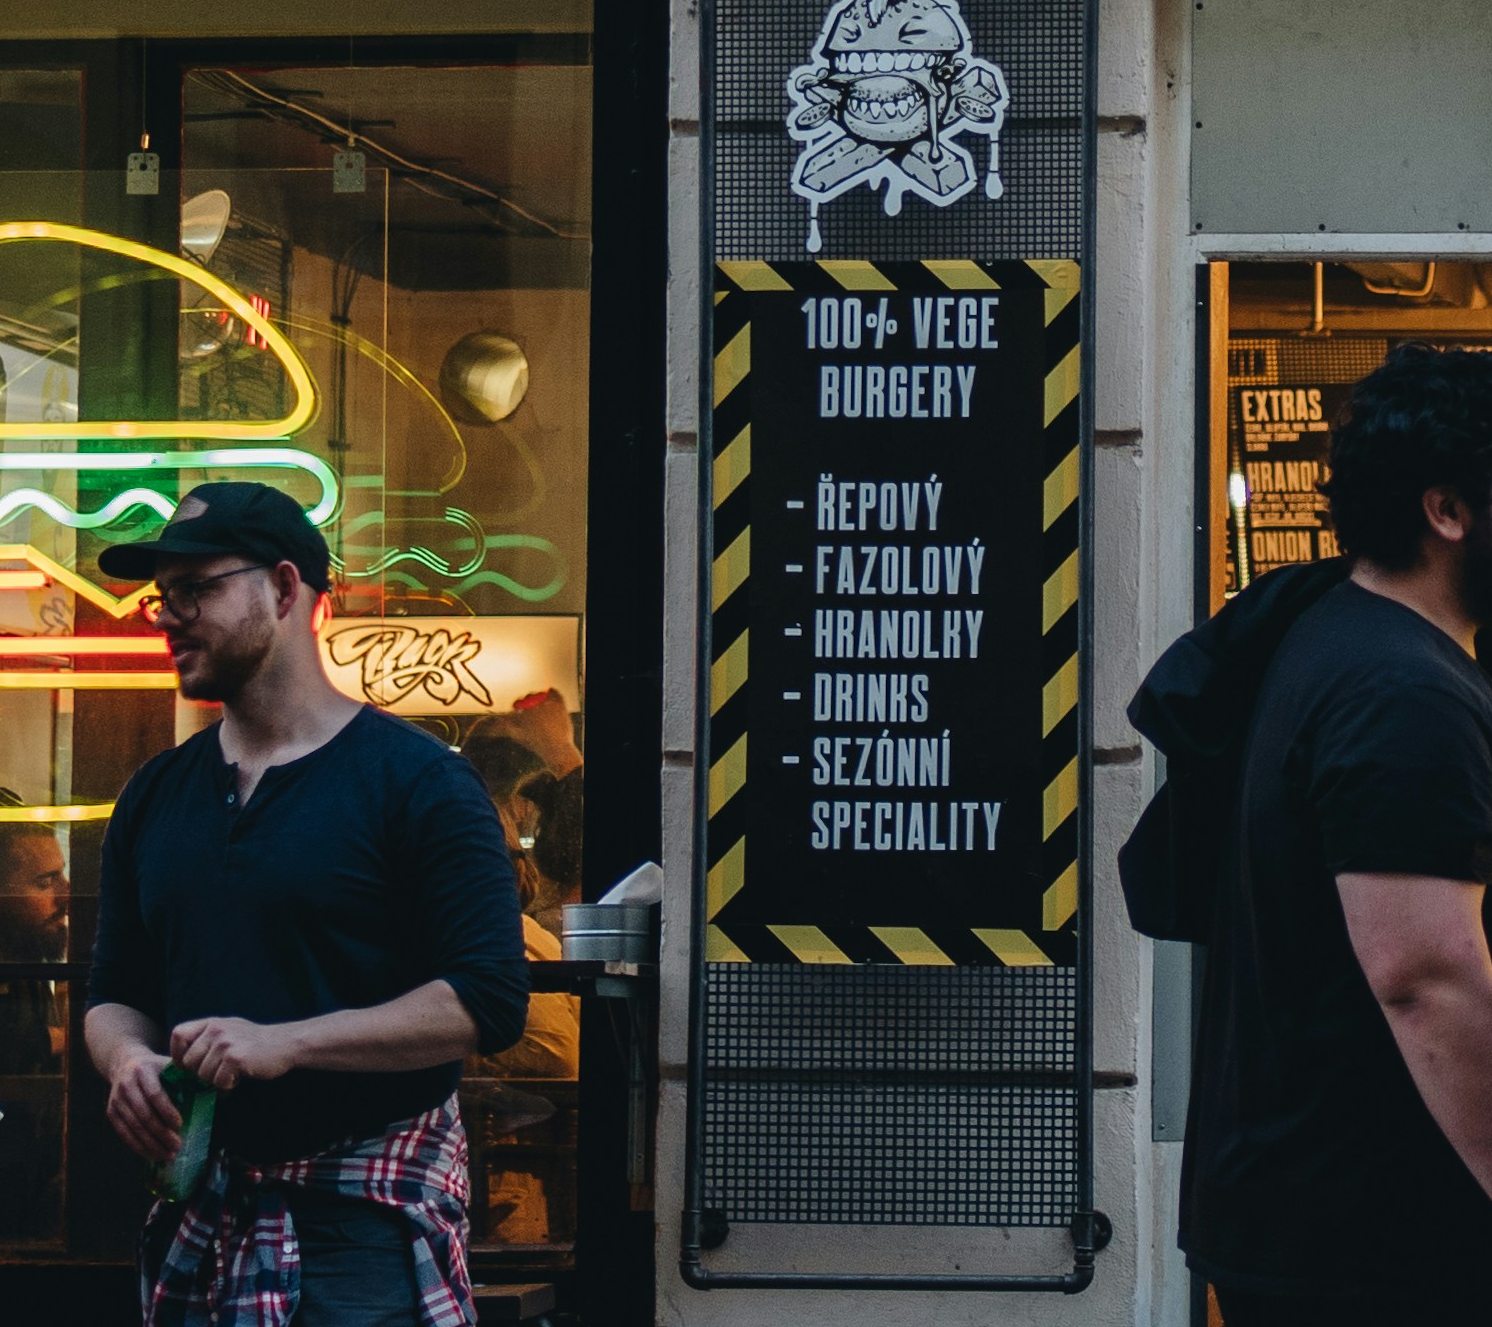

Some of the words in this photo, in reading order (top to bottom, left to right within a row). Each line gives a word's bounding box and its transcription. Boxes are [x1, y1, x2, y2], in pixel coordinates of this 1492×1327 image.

[801, 296, 899, 351] 100%
[913, 296, 1001, 351] VEGE
[819, 365, 976, 419] BURGERY
[1241, 389, 1323, 422] EXTRAS
[816, 474, 943, 532] ŘEPOVÝ
[815, 538, 986, 596] FAZOLOVÝ
[1251, 530, 1313, 562] ONION
[813, 610, 985, 660] HRANOLKY
[812, 674, 930, 724] DRINKS
[811, 730, 952, 788] SEZÓNNÍ
[810, 801, 1003, 852] SPECIALITY
